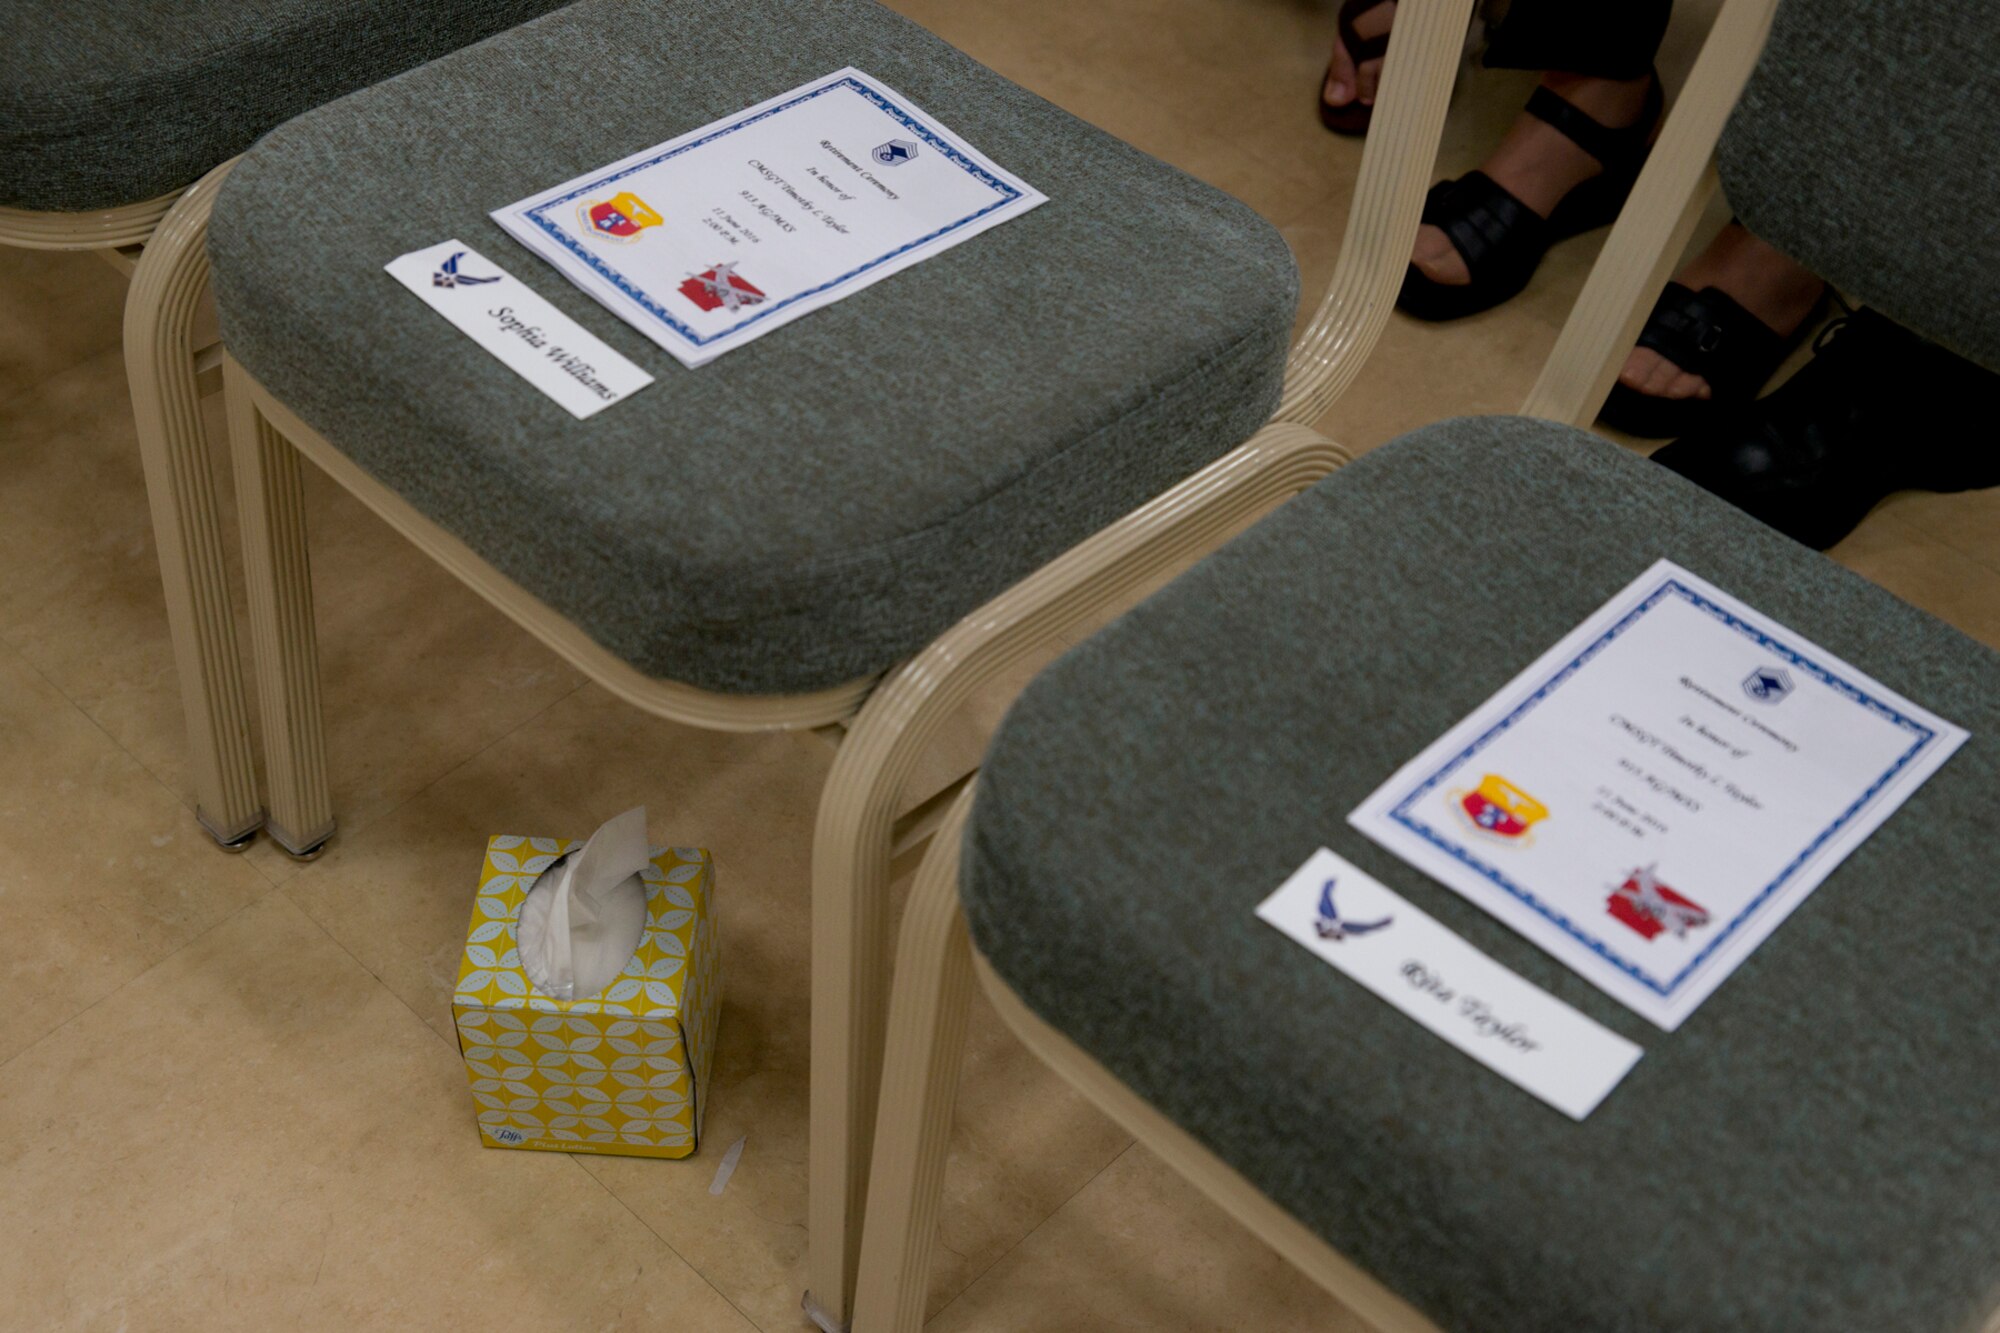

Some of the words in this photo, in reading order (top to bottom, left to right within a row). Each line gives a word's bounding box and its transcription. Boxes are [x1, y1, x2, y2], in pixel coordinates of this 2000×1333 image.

[805, 166, 818, 176] In
[816, 175, 842, 192] honor
[820, 140, 863, 172] Retirement
[860, 172, 899, 200] Ceremony
[781, 183, 814, 210] Timothy
[822, 214, 850, 234] Taylor
[488, 306, 546, 349] Sophia
[546, 345, 617, 400] Williams
[1458, 995, 1542, 1054] Taylor
